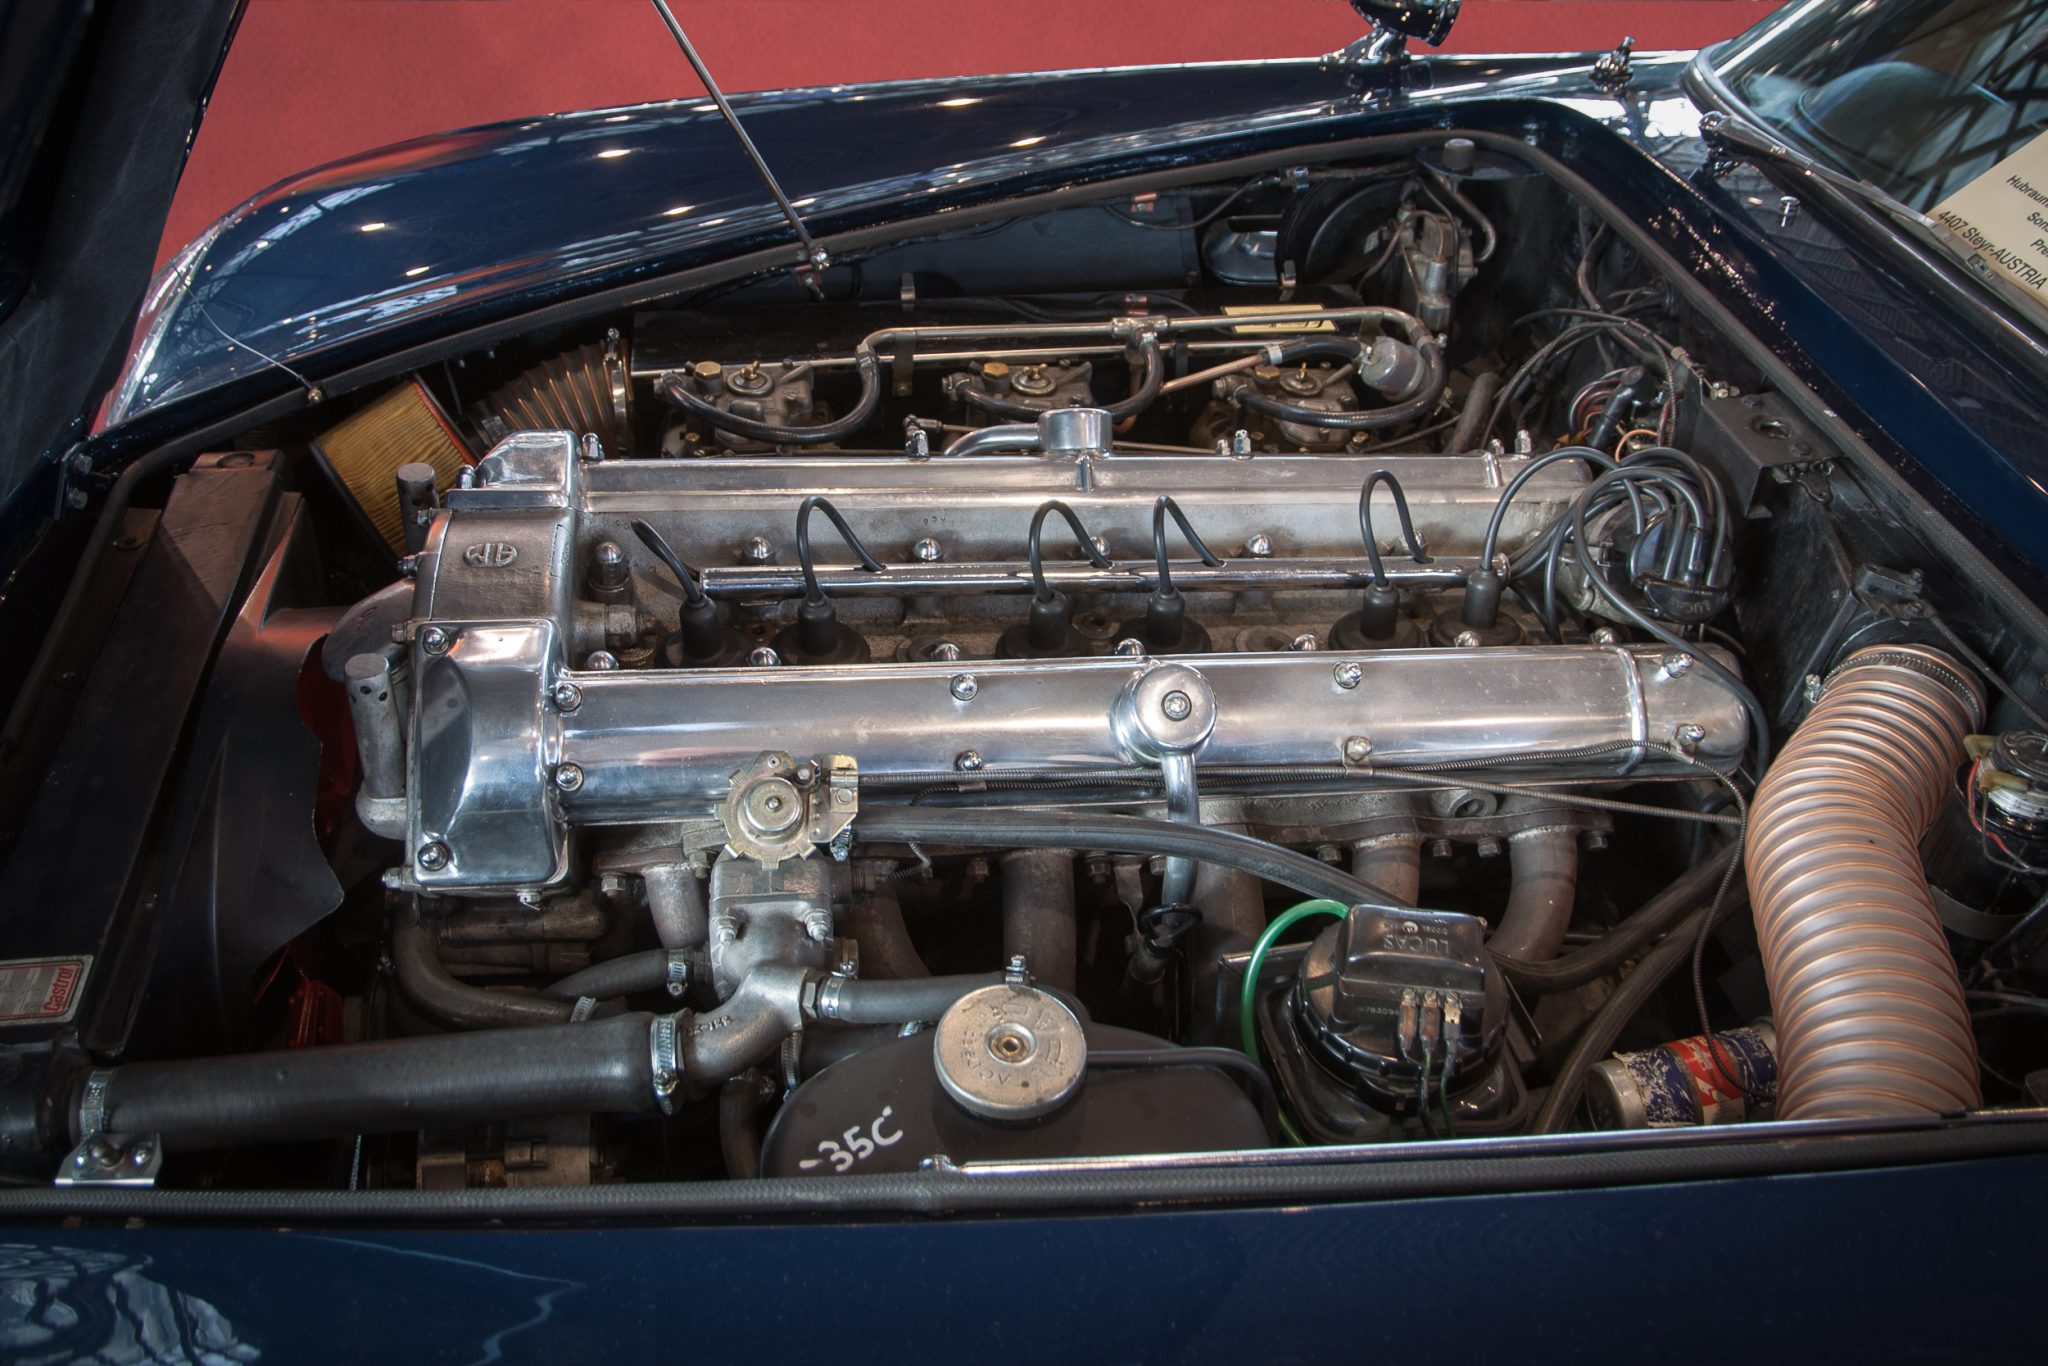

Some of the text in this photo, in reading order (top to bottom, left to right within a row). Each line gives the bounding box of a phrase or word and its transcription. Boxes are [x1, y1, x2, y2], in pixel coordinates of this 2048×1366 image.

[1938, 211, 2047, 290] 4407 Steyr-AUSTRIA
[2030, 238, 2048, 258] Pre
[1383, 934, 1449, 954] LUCAS
[43, 967, 75, 1012] Castrol
